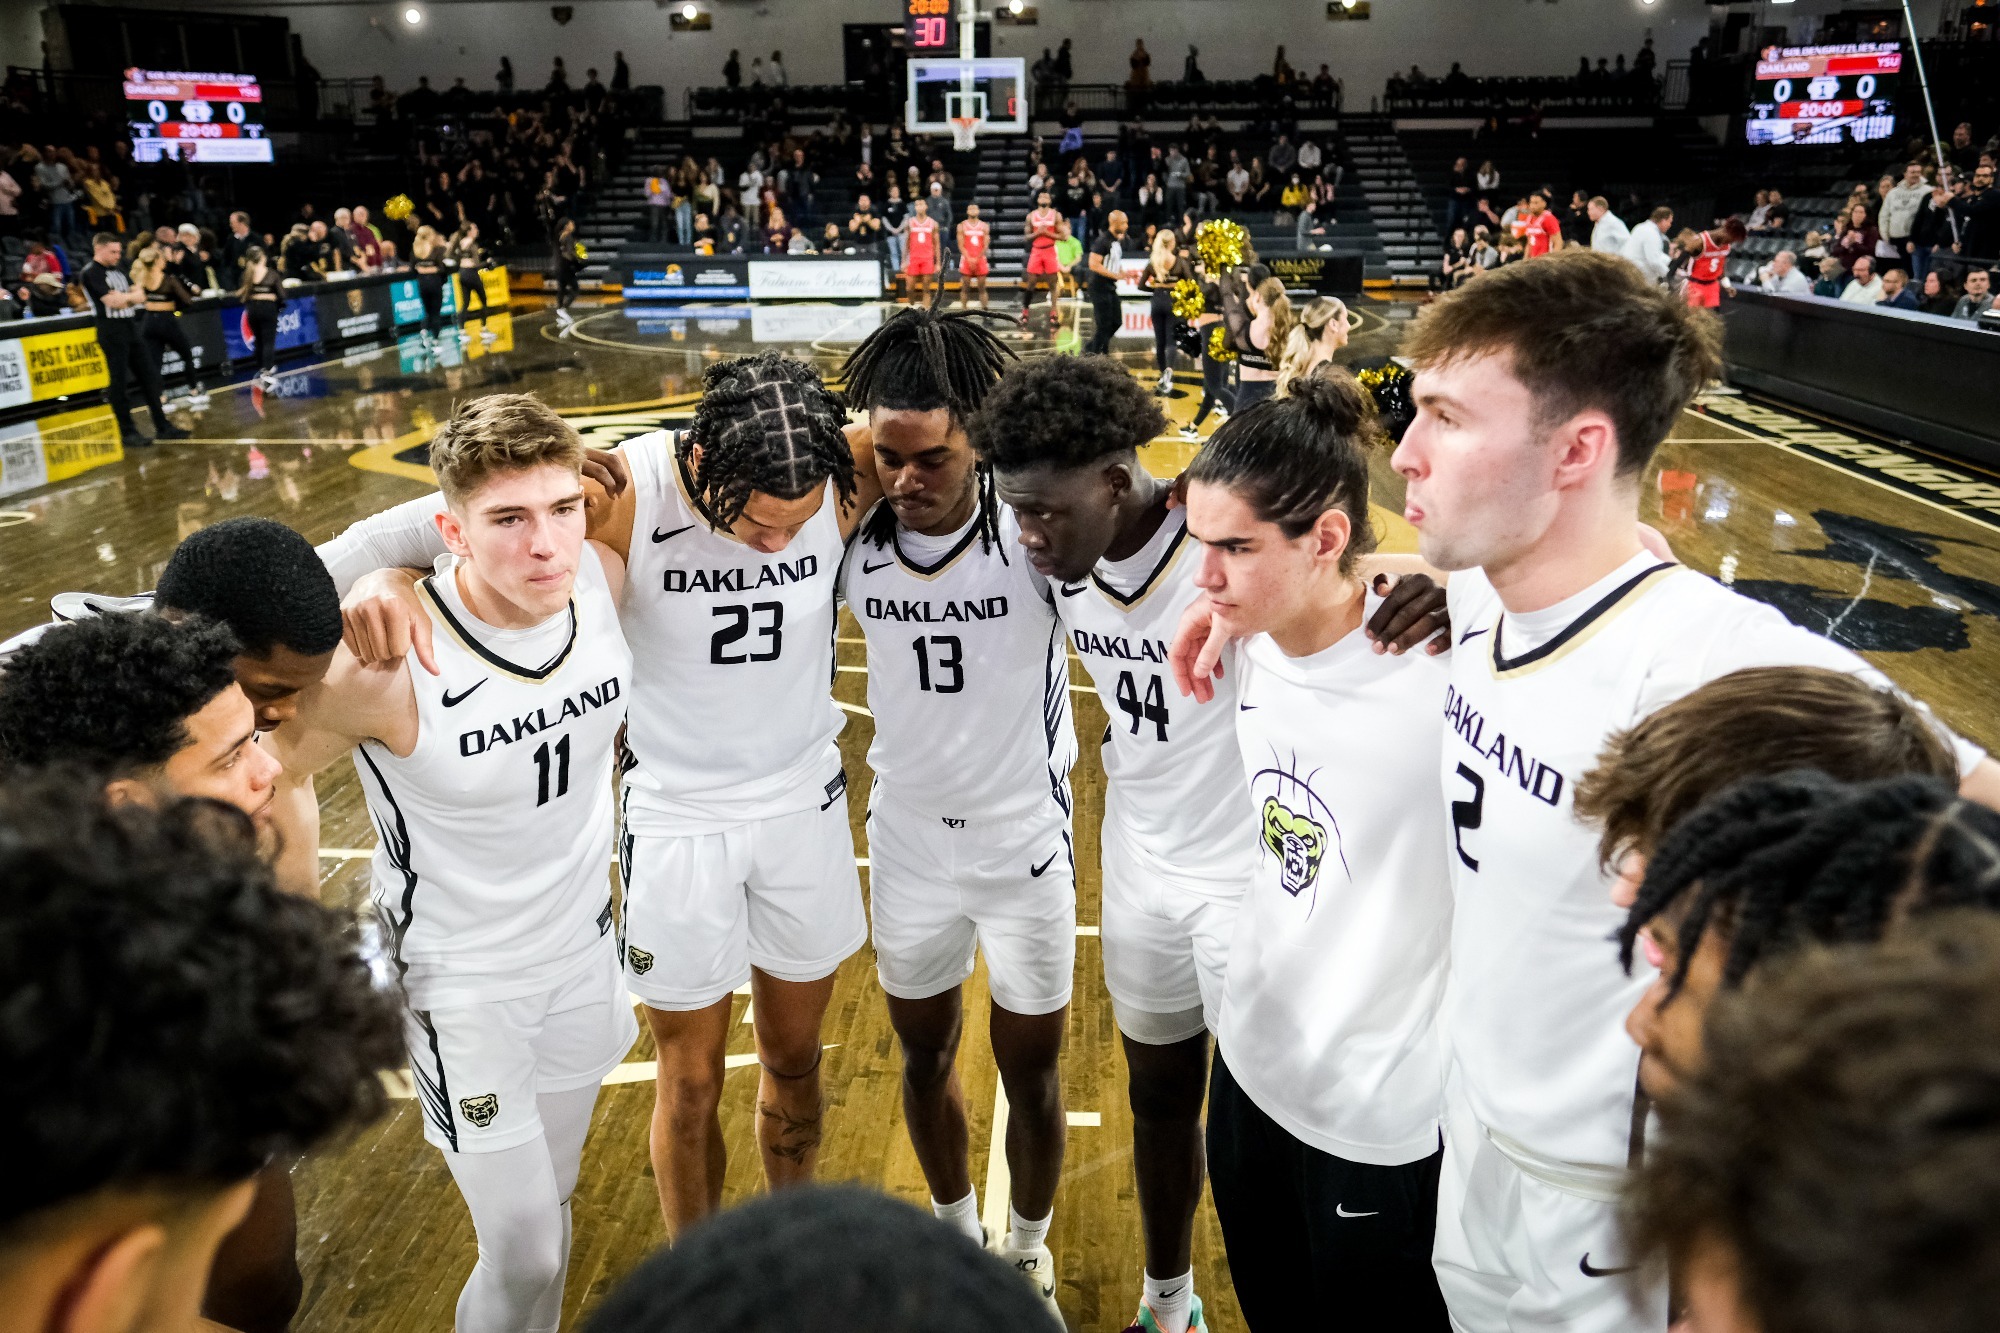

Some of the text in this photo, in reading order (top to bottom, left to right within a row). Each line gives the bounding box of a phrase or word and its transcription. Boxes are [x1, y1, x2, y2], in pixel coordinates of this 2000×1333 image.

[914, 17, 947, 47] 30
[1757, 56, 1900, 74] OAKLAND YSU
[1773, 78, 1793, 103] 0
[1855, 74, 1877, 99] 0
[147, 100, 168, 124] 0
[226, 101, 246, 124] 0
[1797, 102, 1844, 119] 20:00
[179, 122, 223, 138] 20:00
[29, 346, 62, 368] POST
[64, 341, 99, 362] GAME
[32, 360, 103, 386] HEADQUARTERS
[663, 554, 818, 593] OAKLAND
[865, 596, 1009, 622] OAKLAND
[710, 601, 784, 664] 23
[1073, 629, 1170, 664] OAKLAN
[912, 635, 964, 693] 13
[459, 676, 621, 757] OAKLAND
[1115, 671, 1169, 742] 44
[1443, 683, 1563, 807] OAKLAND
[533, 733, 570, 807] 11
[1451, 761, 1484, 873] 2
